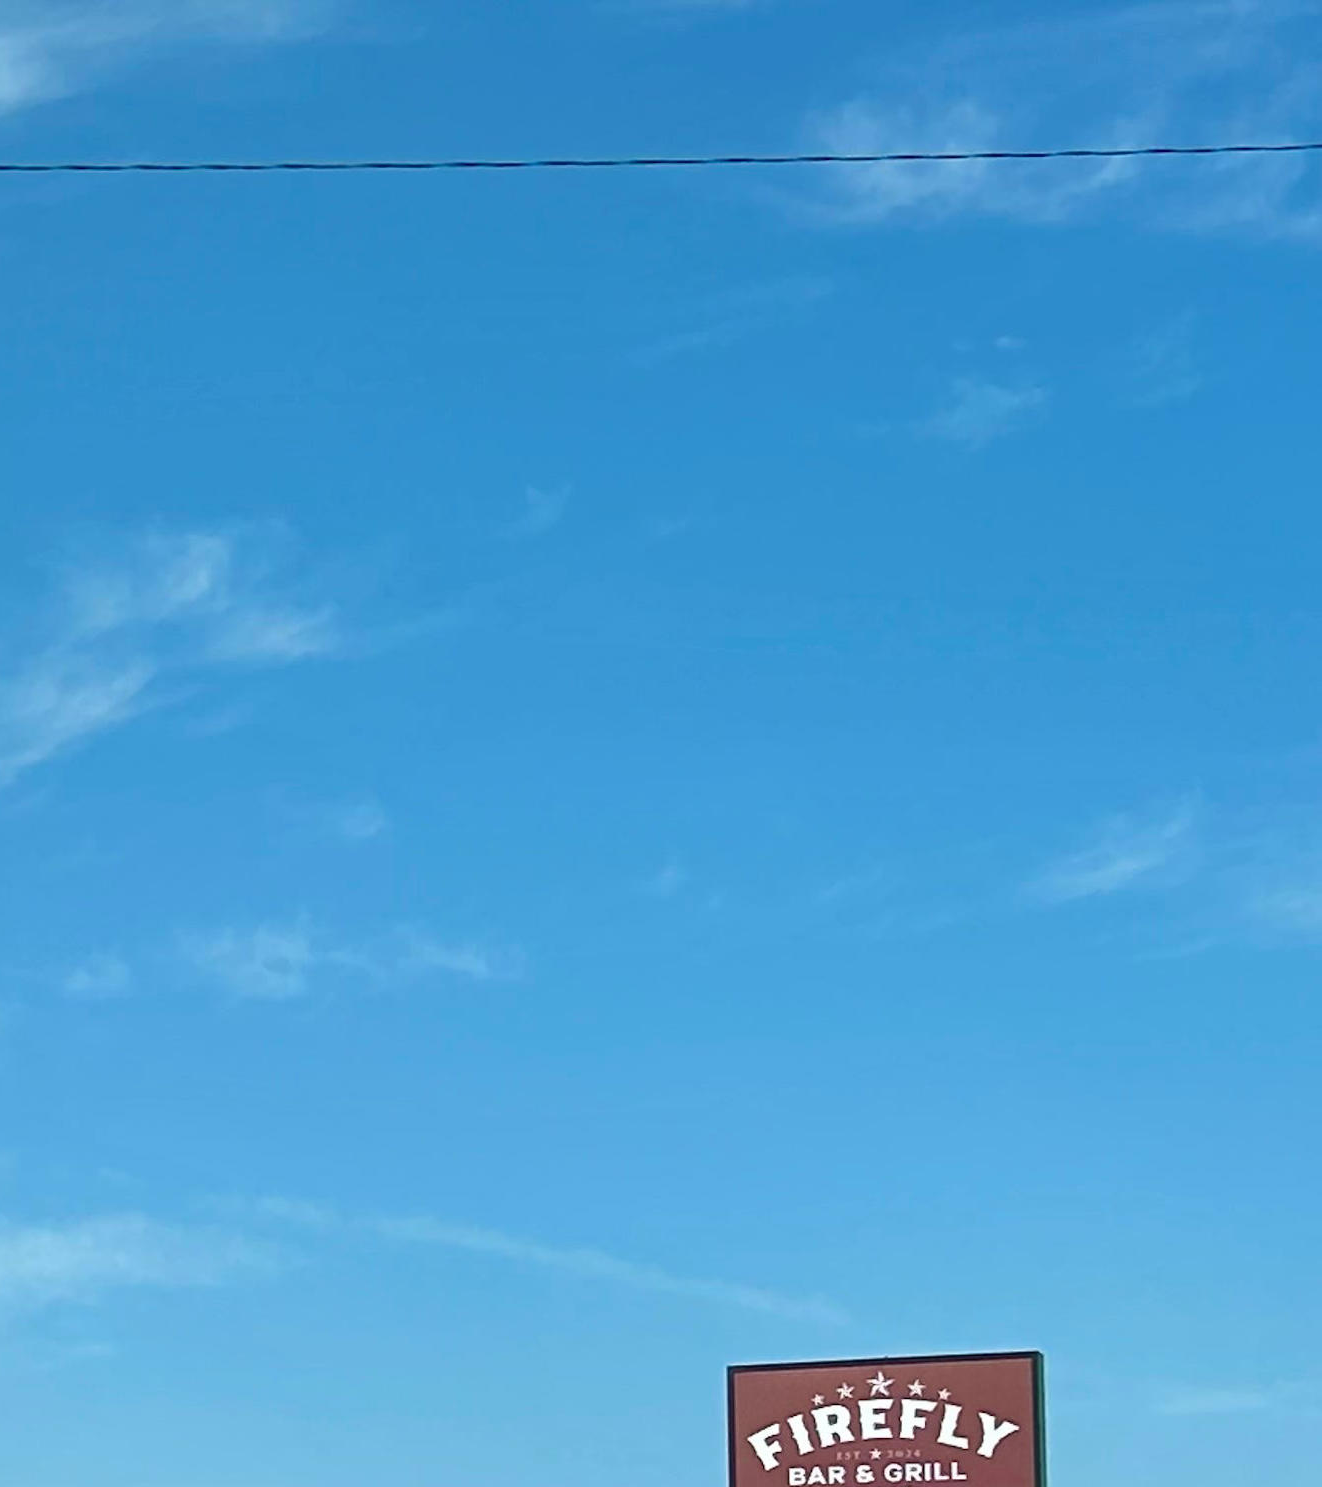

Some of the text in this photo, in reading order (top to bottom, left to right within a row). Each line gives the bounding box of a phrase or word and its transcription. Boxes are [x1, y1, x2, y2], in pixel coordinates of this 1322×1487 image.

[746, 1398, 1020, 1471] FIREFLY
[787, 1460, 967, 1487] BAR & GRILL
